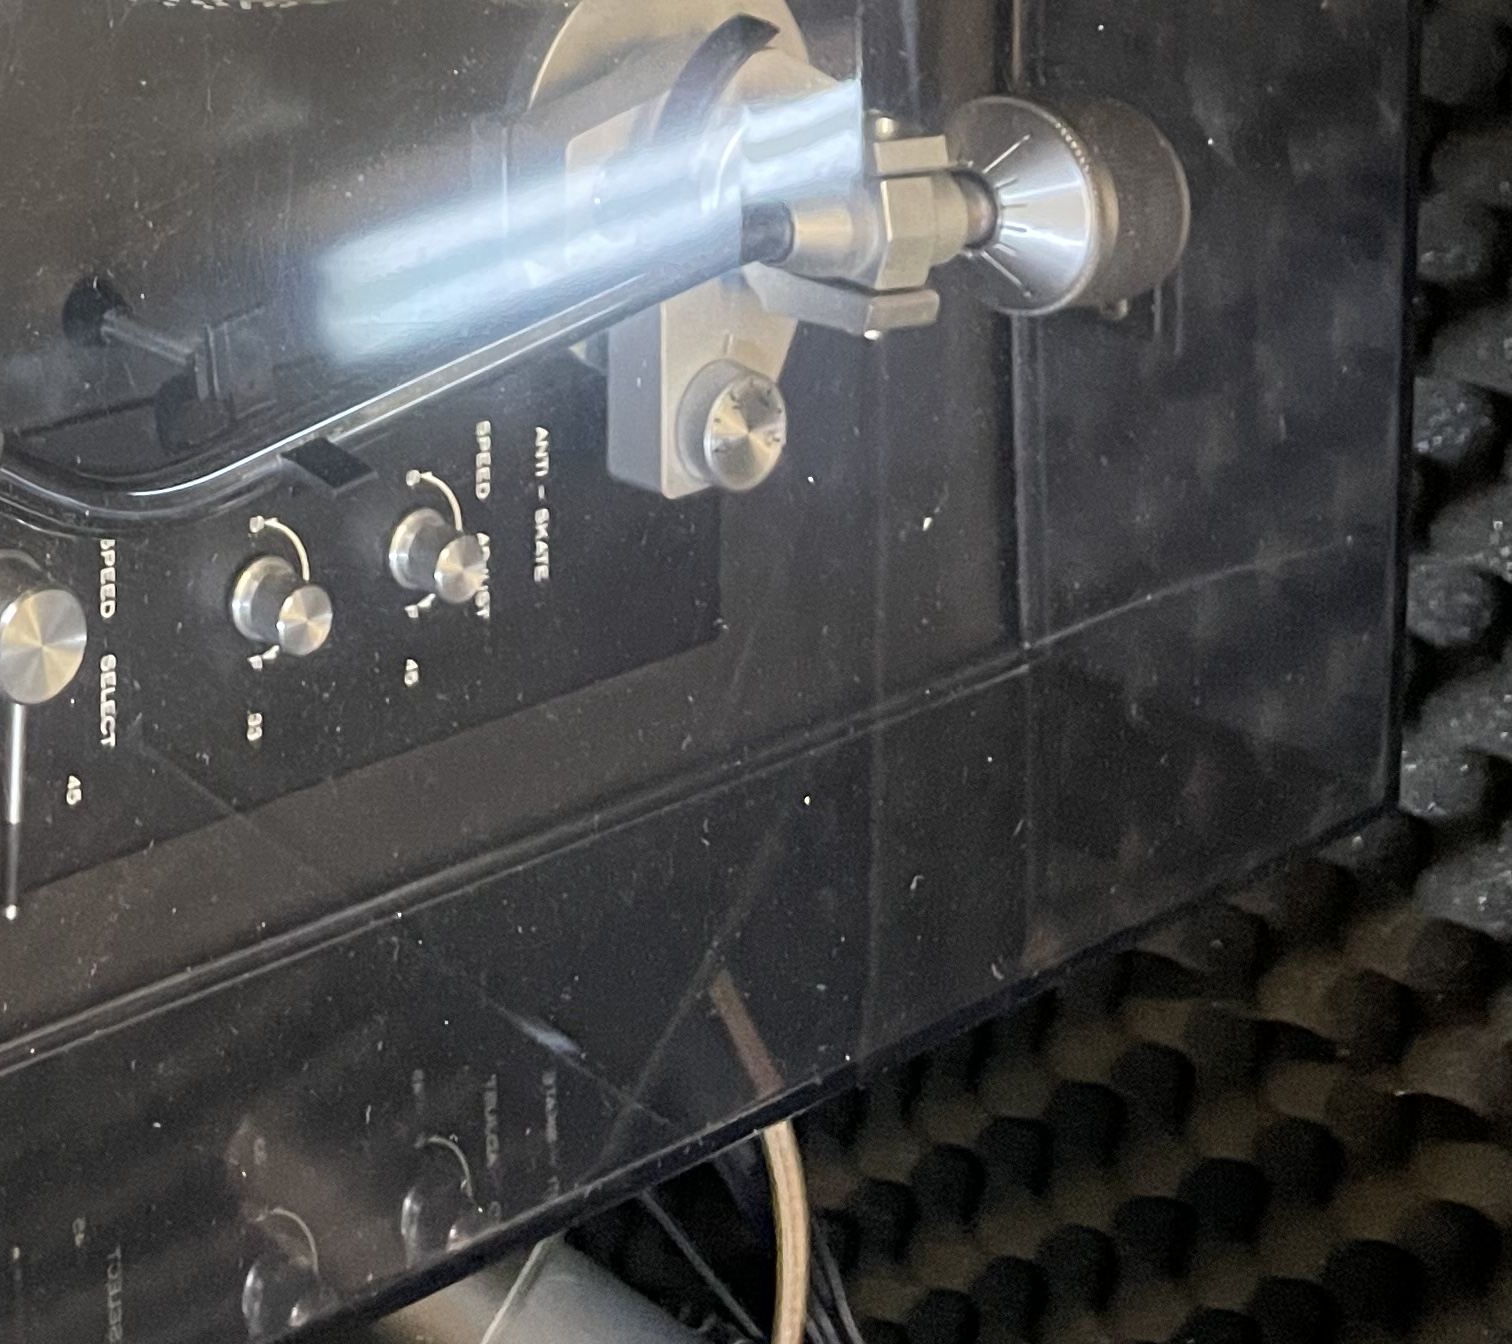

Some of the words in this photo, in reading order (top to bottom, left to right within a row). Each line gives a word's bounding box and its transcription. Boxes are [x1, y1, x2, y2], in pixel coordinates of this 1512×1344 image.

[475, 420, 492, 501] SPEED
[534, 426, 550, 477] ANTI
[99, 539, 117, 620] SPEED
[534, 508, 550, 583] SKATE
[99, 654, 117, 748] SELECT
[65, 775, 83, 806] 45
